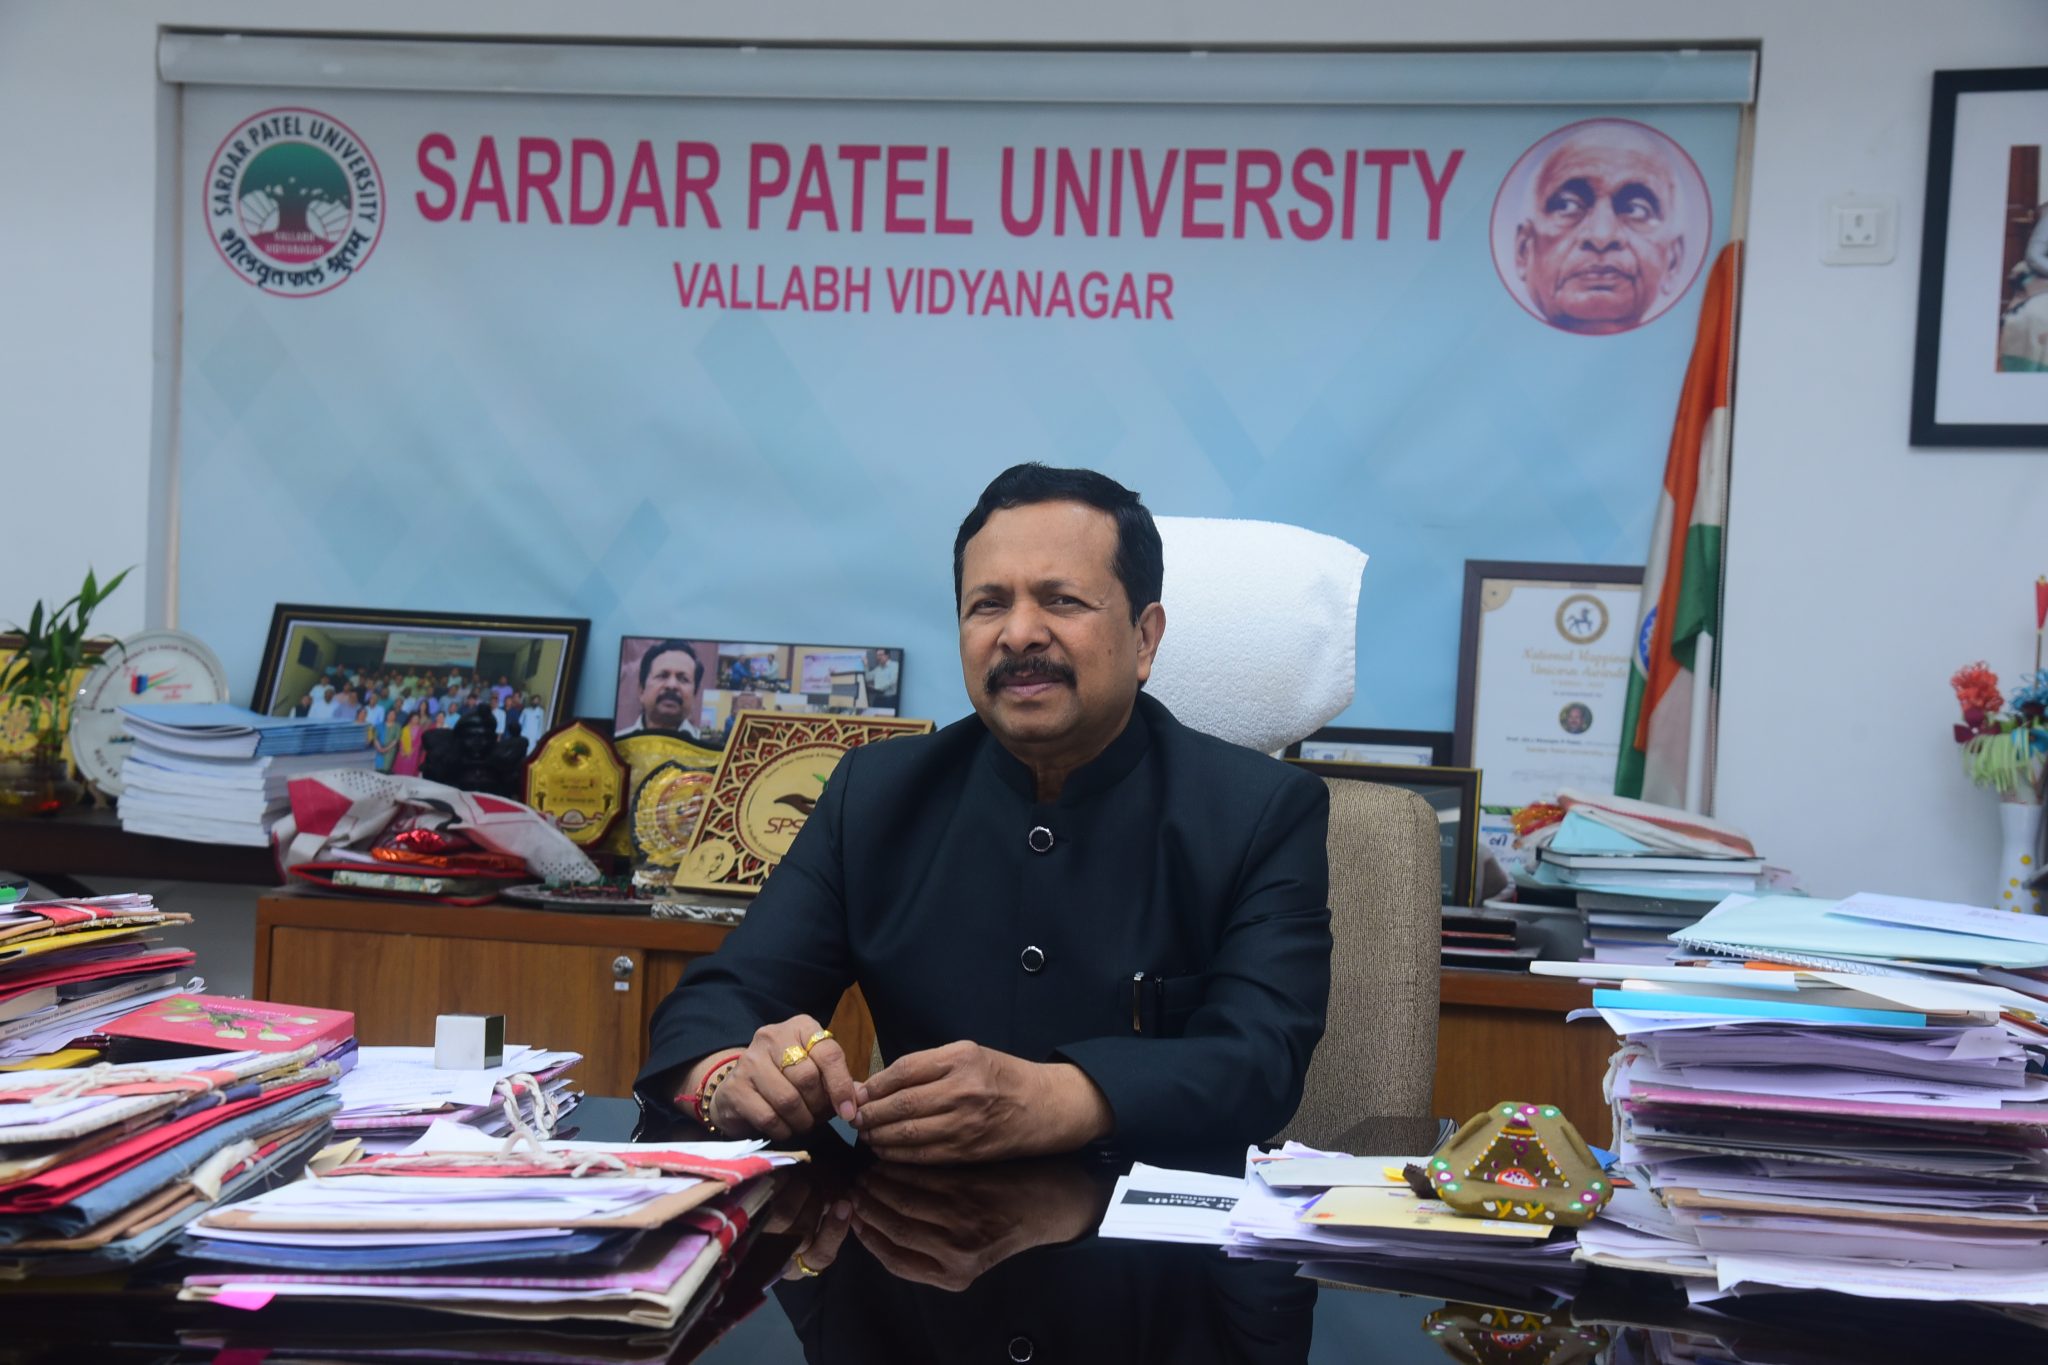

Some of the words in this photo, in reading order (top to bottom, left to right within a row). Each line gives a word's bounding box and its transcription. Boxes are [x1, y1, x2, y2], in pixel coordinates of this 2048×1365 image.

[213, 139, 251, 217] SARDAR
[248, 116, 303, 146] PATEL
[310, 119, 377, 224] UNIVERSITY
[416, 134, 720, 228] SARDAR
[748, 144, 973, 235] PATEL
[1001, 148, 1464, 241] UNIVERSITY
[675, 263, 871, 312] VALLABH
[887, 268, 1173, 320] VIDYANAGAR
